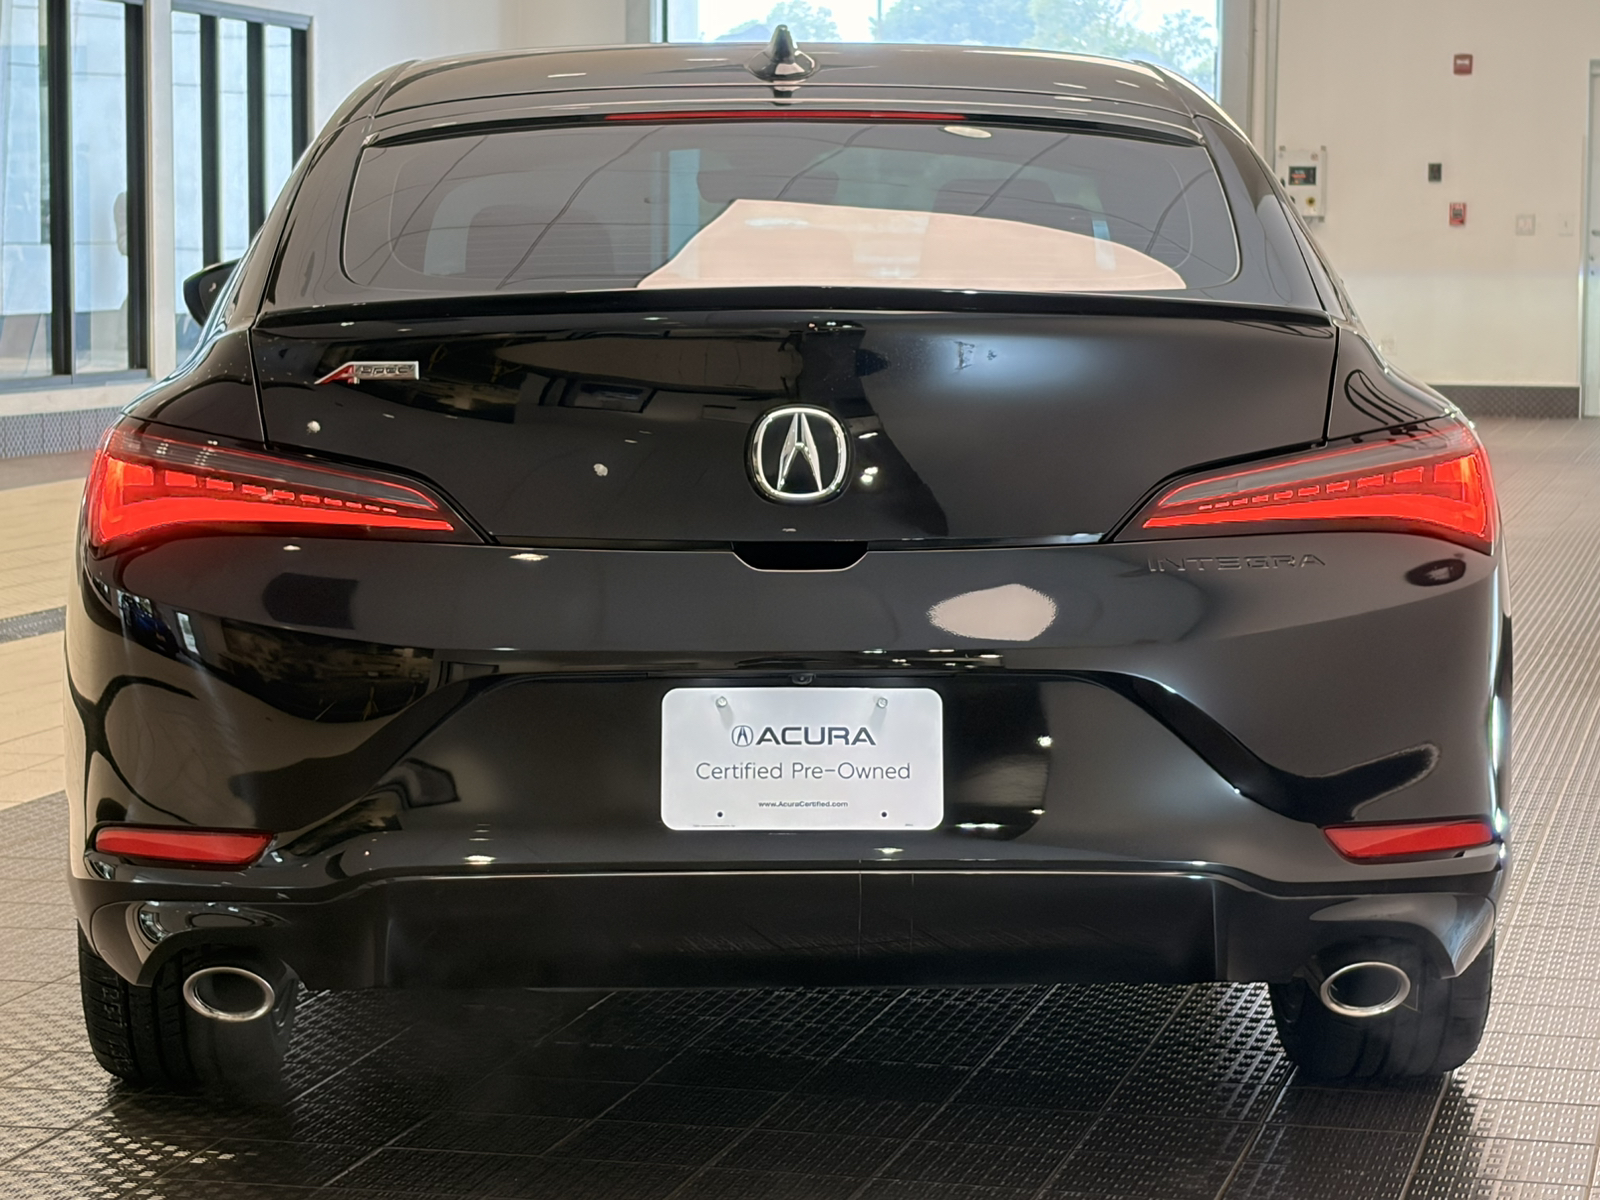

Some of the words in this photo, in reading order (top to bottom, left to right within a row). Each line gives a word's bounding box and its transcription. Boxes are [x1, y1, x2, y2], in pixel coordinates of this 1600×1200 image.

[1148, 554, 1326, 572] INTEGRA
[755, 726, 877, 746] ACURA
[695, 761, 783, 780] Certified
[791, 761, 911, 780] Pre-Owned
[758, 800, 849, 808] www.AcuraCertified.com
